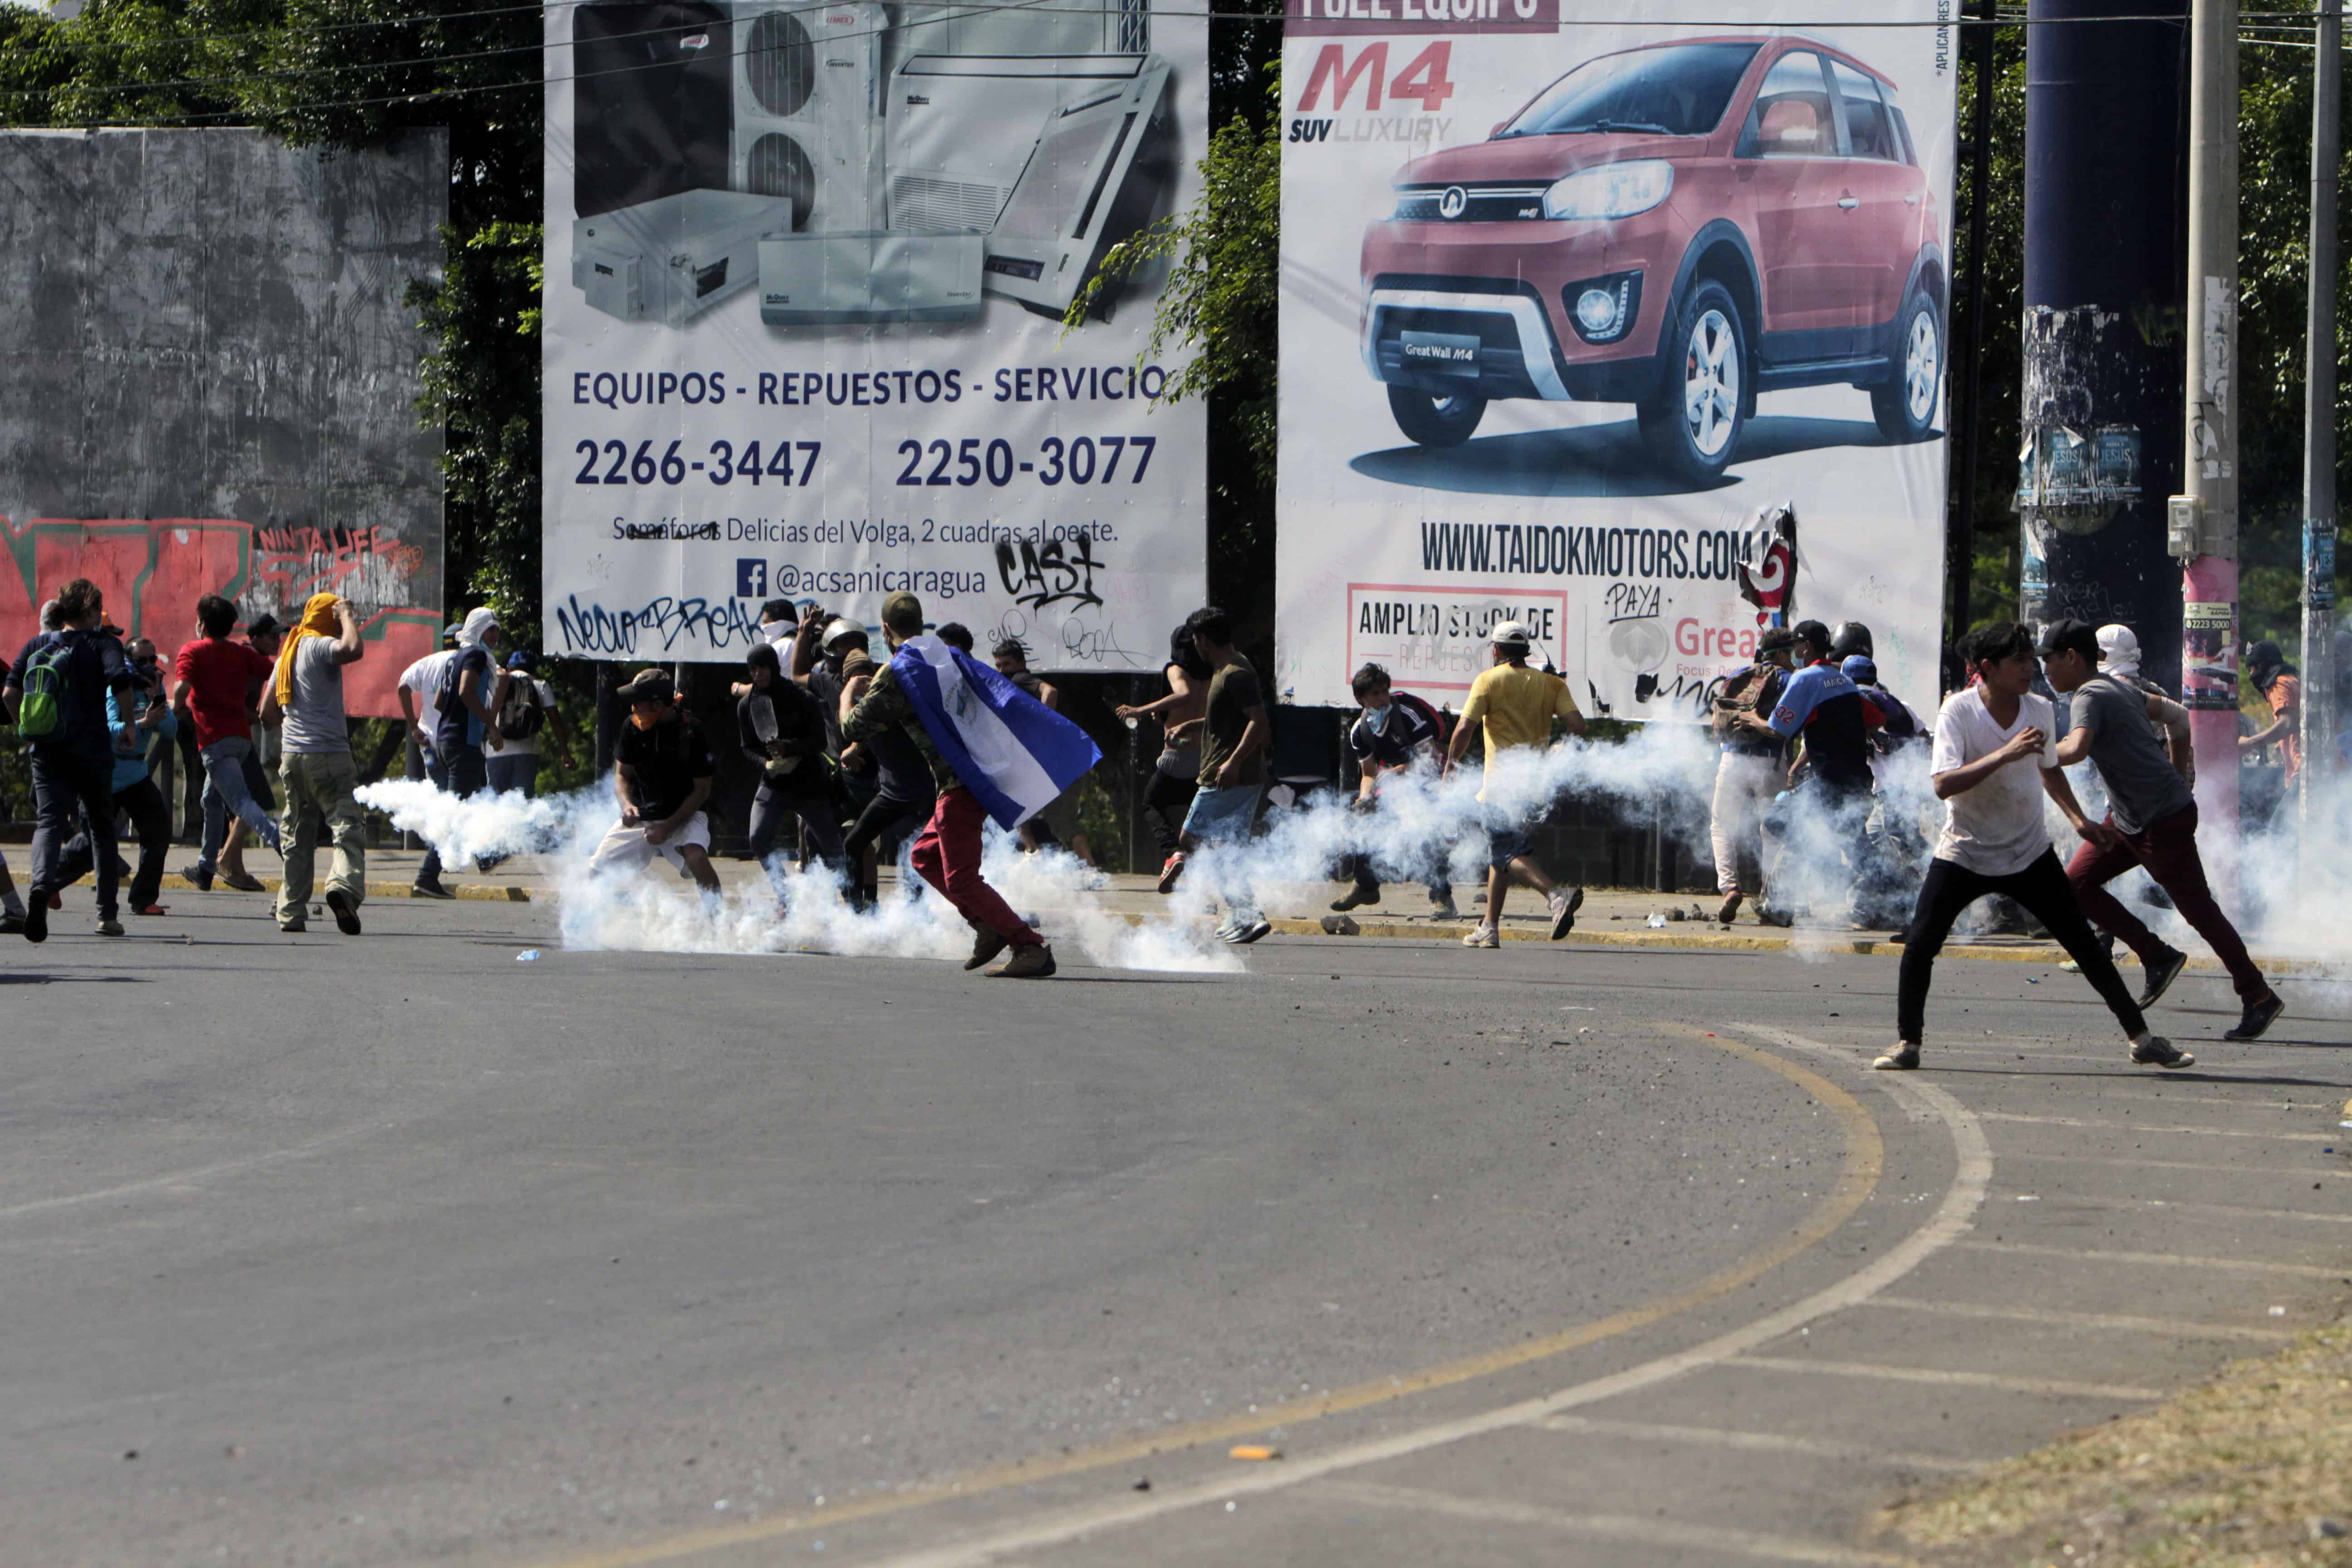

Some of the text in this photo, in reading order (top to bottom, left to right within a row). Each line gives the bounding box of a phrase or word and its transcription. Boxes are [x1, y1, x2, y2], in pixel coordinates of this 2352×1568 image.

[1296, 41, 1454, 111] M4
[1289, 117, 1452, 143] SUV LUXURY
[1406, 343, 1474, 361] Great Wall M4
[573, 372, 726, 410] EQUIPOS
[758, 369, 962, 406] REPUESTOS
[994, 365, 1167, 402] SERVICIO
[575, 436, 1156, 487] 2266-3447 2250-3077
[727, 518, 808, 543] Delicias
[814, 519, 843, 544] del
[850, 518, 915, 548] Volga,
[921, 519, 935, 542] 2
[940, 519, 1022, 544] cuadras
[1029, 519, 1045, 544] al
[1052, 519, 1118, 543] oeste.
[776, 563, 985, 599] @acsanicaragua
[1528, 608, 1553, 640] DE
[2192, 620, 2230, 629] 2223 5000
[1676, 663, 1711, 676] Focus
[1774, 706, 1795, 725] 32
